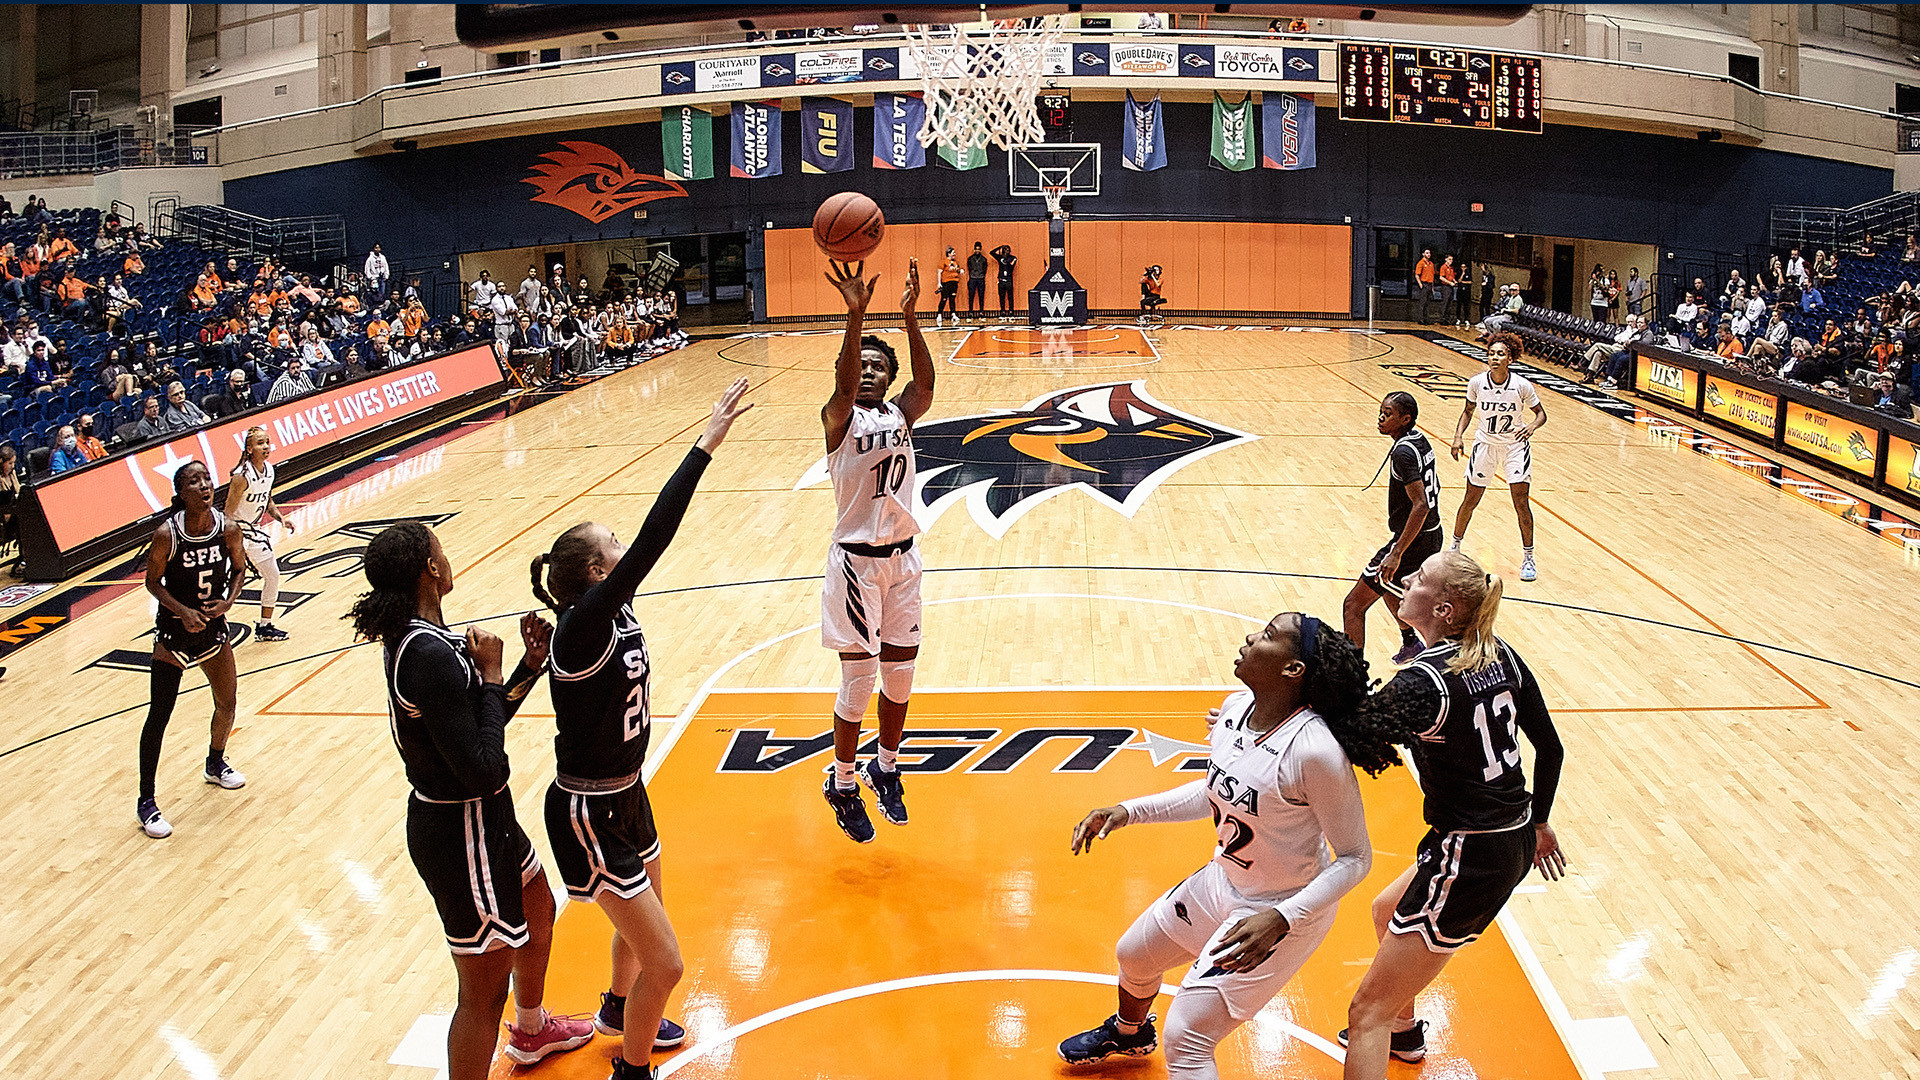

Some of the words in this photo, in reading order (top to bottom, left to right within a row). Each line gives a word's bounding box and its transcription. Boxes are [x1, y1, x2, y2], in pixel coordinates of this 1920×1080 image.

[800, 57, 858, 68] COLDFIRE
[1365, 54, 1372, 64] 2
[1382, 55, 1388, 65] 3
[1394, 53, 1416, 61] UTSA
[1430, 50, 1466, 68] 9:27
[699, 58, 757, 70] COURTYARD
[1218, 61, 1279, 73] TOYOTA
[1348, 64, 1356, 74] 2
[1365, 65, 1372, 75] 0
[1381, 66, 1388, 76] 0
[1405, 67, 1423, 76] UTSA
[1465, 72, 1478, 80] SFA
[1501, 65, 1509, 75] 5
[1517, 66, 1524, 76] 0
[1532, 68, 1539, 78] 6
[1349, 75, 1356, 85] 3
[1381, 77, 1388, 87] 2
[1411, 77, 1422, 93] 9
[1438, 81, 1447, 94] 2
[1498, 76, 1509, 86] 13
[1532, 78, 1540, 88] 6
[1365, 86, 1372, 97] 0
[1381, 88, 1389, 98] 0
[1468, 82, 1489, 98] 24
[1496, 86, 1509, 96] 20
[1517, 87, 1524, 97] 0
[1532, 89, 1540, 99] 0
[893, 96, 907, 119] LA
[1044, 98, 1069, 109] 9:27
[1345, 97, 1356, 107] 12
[1381, 98, 1388, 109] 0
[1400, 100, 1409, 114] 0
[1415, 104, 1422, 114] 3
[1496, 96, 1509, 106] 24
[1517, 98, 1524, 107] 0
[1532, 99, 1540, 109] 0
[1050, 109, 1064, 126] 12
[1463, 108, 1471, 117] 4
[1481, 106, 1489, 119] 0
[1496, 107, 1509, 118] 33
[1517, 108, 1525, 119] 0
[1532, 111, 1540, 119] 4
[744, 104, 756, 176] ATLANTIC
[756, 108, 768, 169] FLORIDA
[817, 111, 837, 158] FIU
[1234, 108, 1246, 161] NORTH
[682, 107, 693, 178] CHARLOTTE
[892, 123, 907, 167] TECH
[192, 151, 205, 160] 104
[1650, 361, 1684, 391] UTSA
[1744, 391, 1762, 405] TICKETS
[273, 403, 337, 447] MAKE
[334, 387, 384, 426] LIVES
[381, 370, 442, 409] BETTER
[1481, 401, 1517, 412] UTSA
[1729, 402, 1745, 420] (210)
[1485, 414, 1516, 435] 12
[1804, 412, 1813, 422] OR
[1814, 415, 1828, 428] VISIT
[854, 429, 910, 455] UTSA
[870, 453, 908, 500] 10
[182, 545, 223, 568] SFA
[197, 569, 213, 600] 5
[1473, 690, 1519, 782] 13
